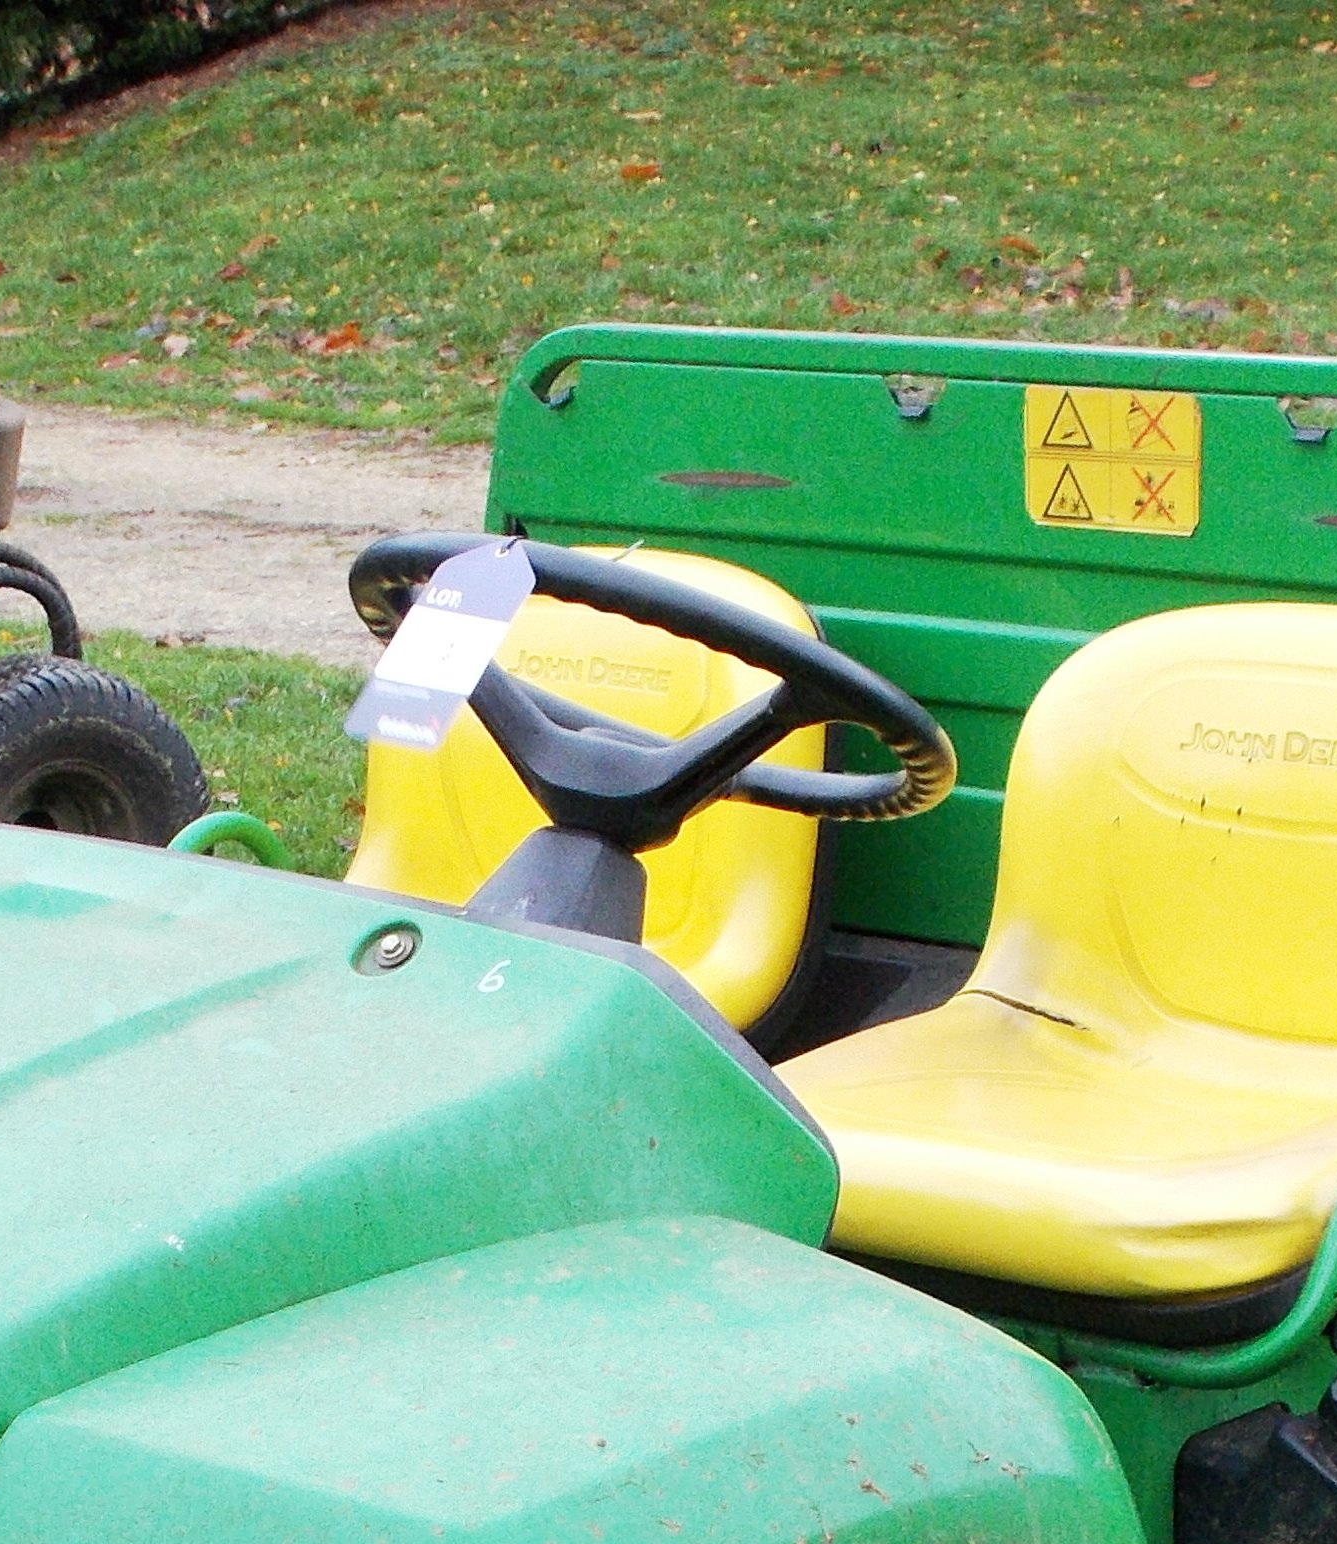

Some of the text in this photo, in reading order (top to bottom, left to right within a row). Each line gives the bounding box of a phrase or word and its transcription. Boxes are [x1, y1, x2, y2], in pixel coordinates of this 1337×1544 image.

[507, 649, 671, 694] JOHN DEERE
[1179, 722, 1277, 759] JOHN
[477, 959, 511, 993] 6
